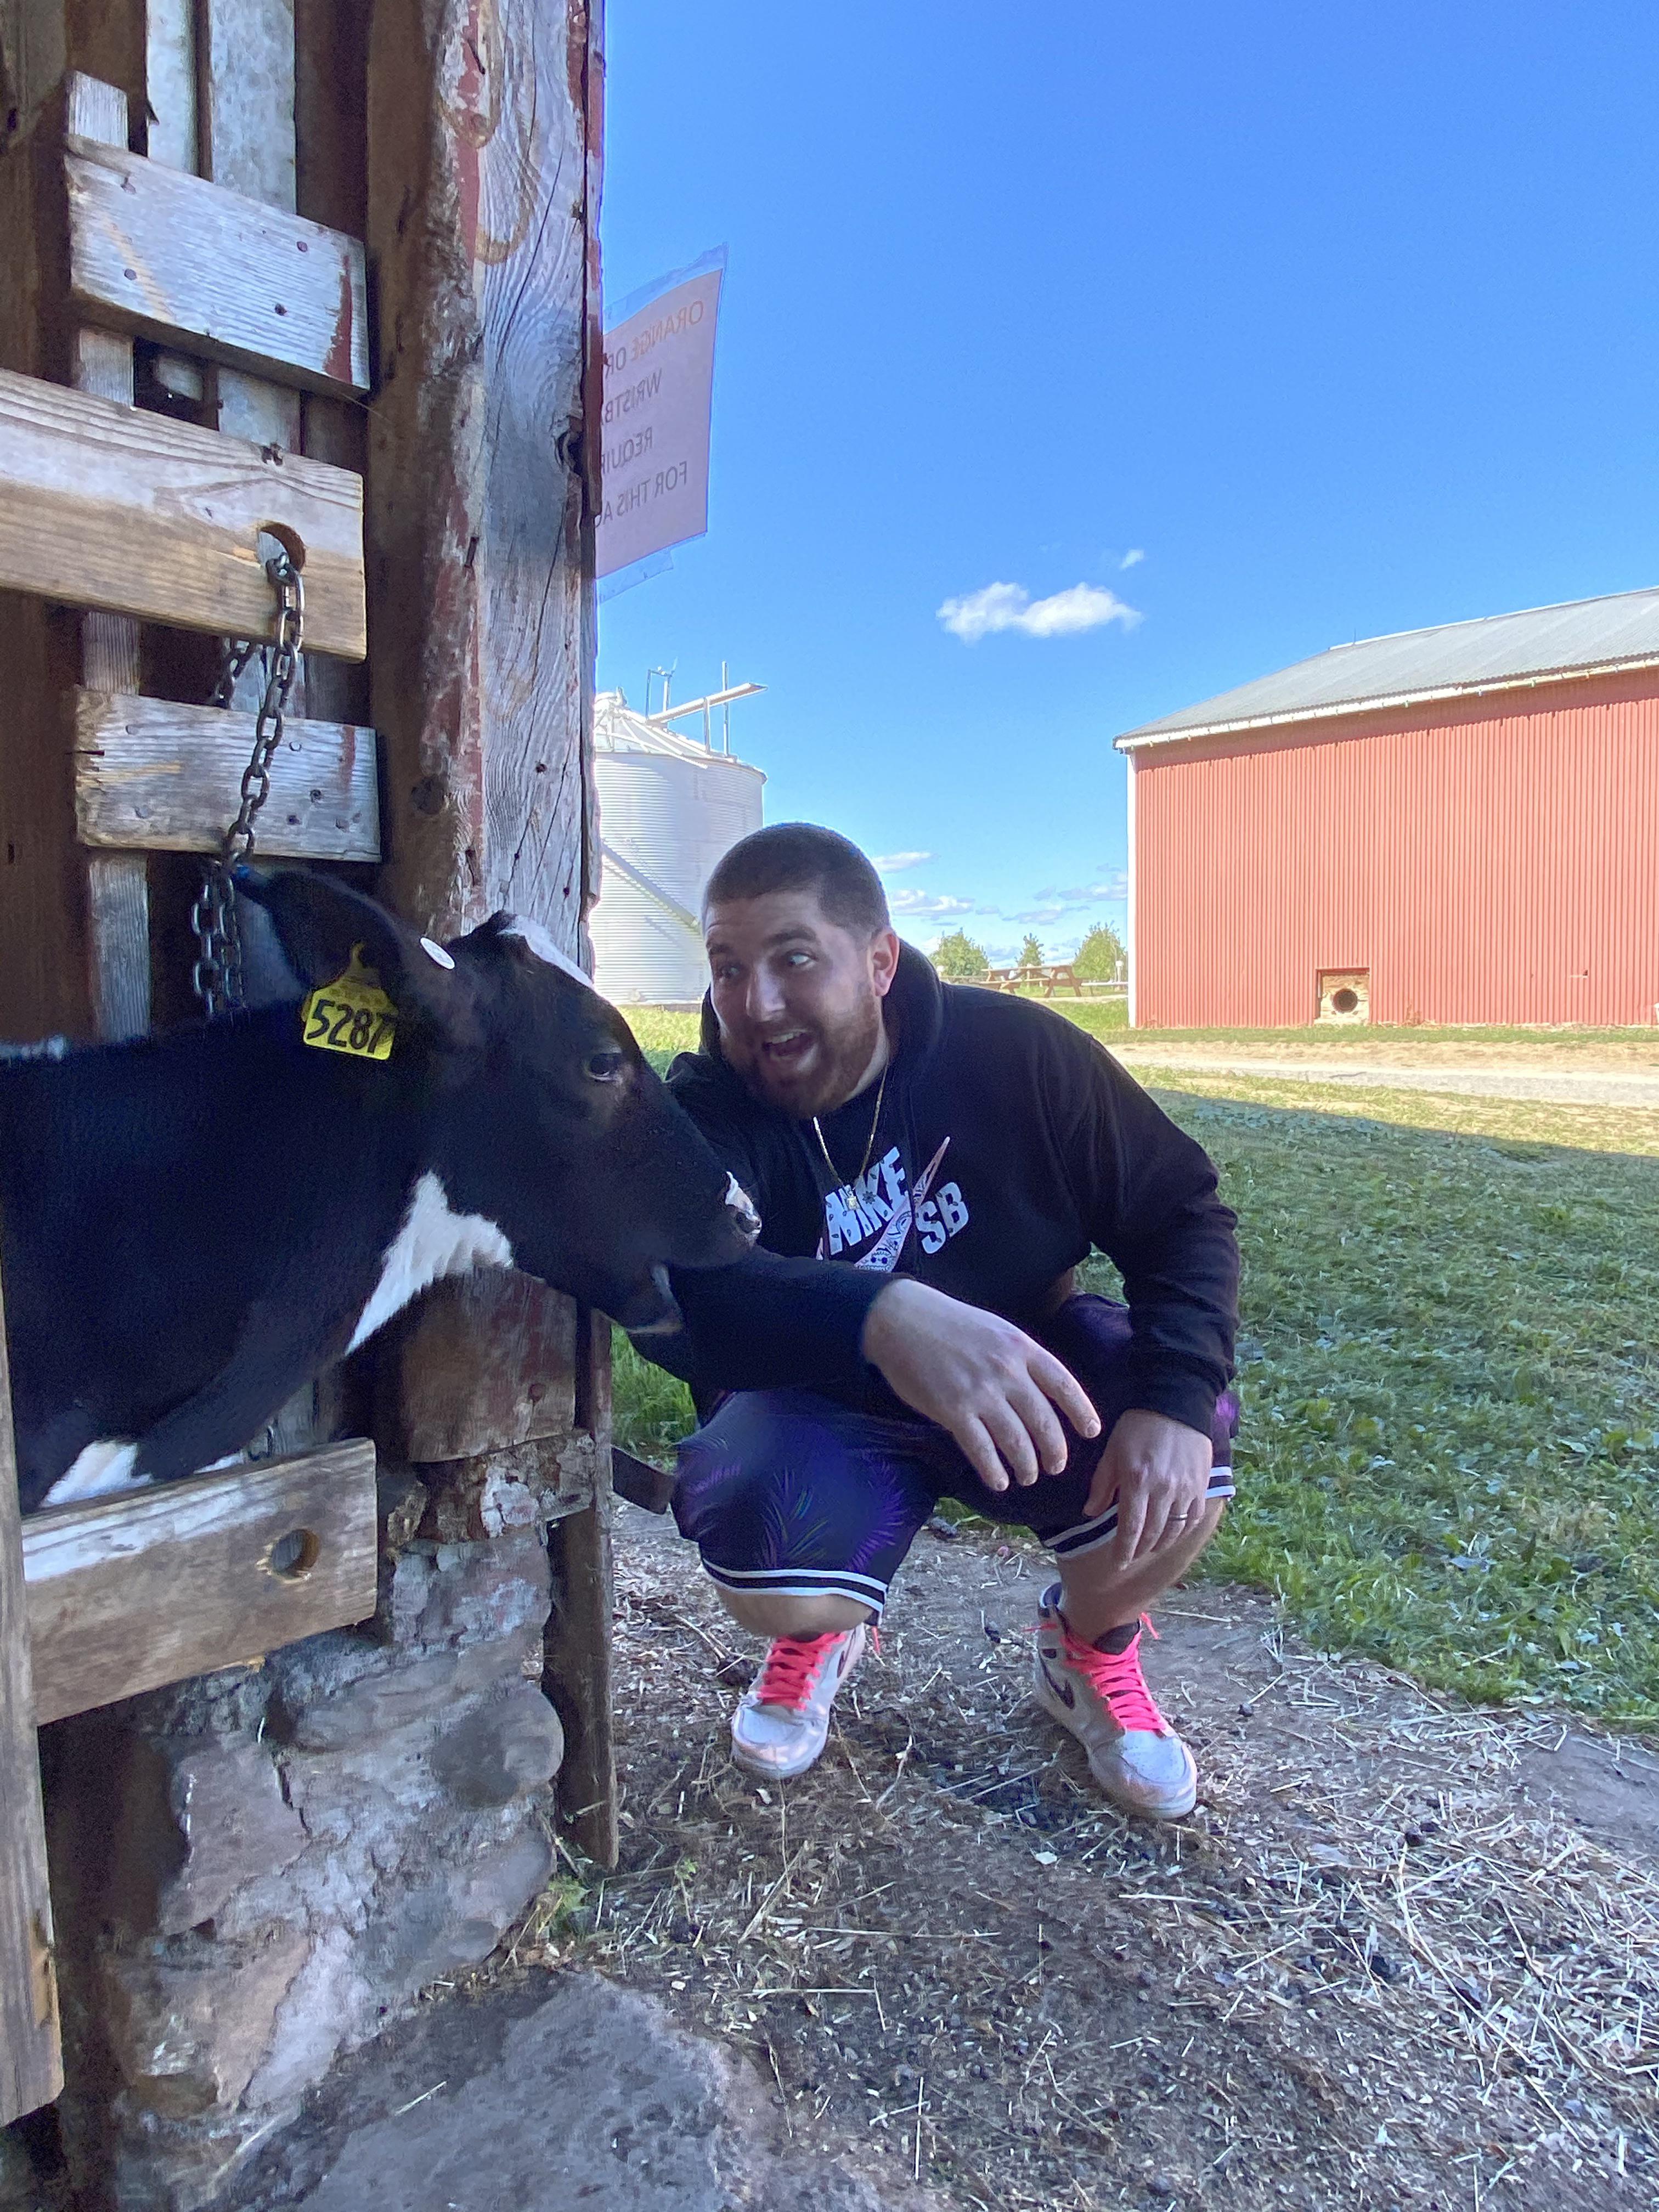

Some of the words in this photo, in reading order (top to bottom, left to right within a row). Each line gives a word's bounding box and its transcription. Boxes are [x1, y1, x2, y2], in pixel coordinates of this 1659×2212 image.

[306, 999, 397, 1054] 5287
[825, 1146, 909, 1256] NIKE
[915, 1182, 969, 1254] SB
